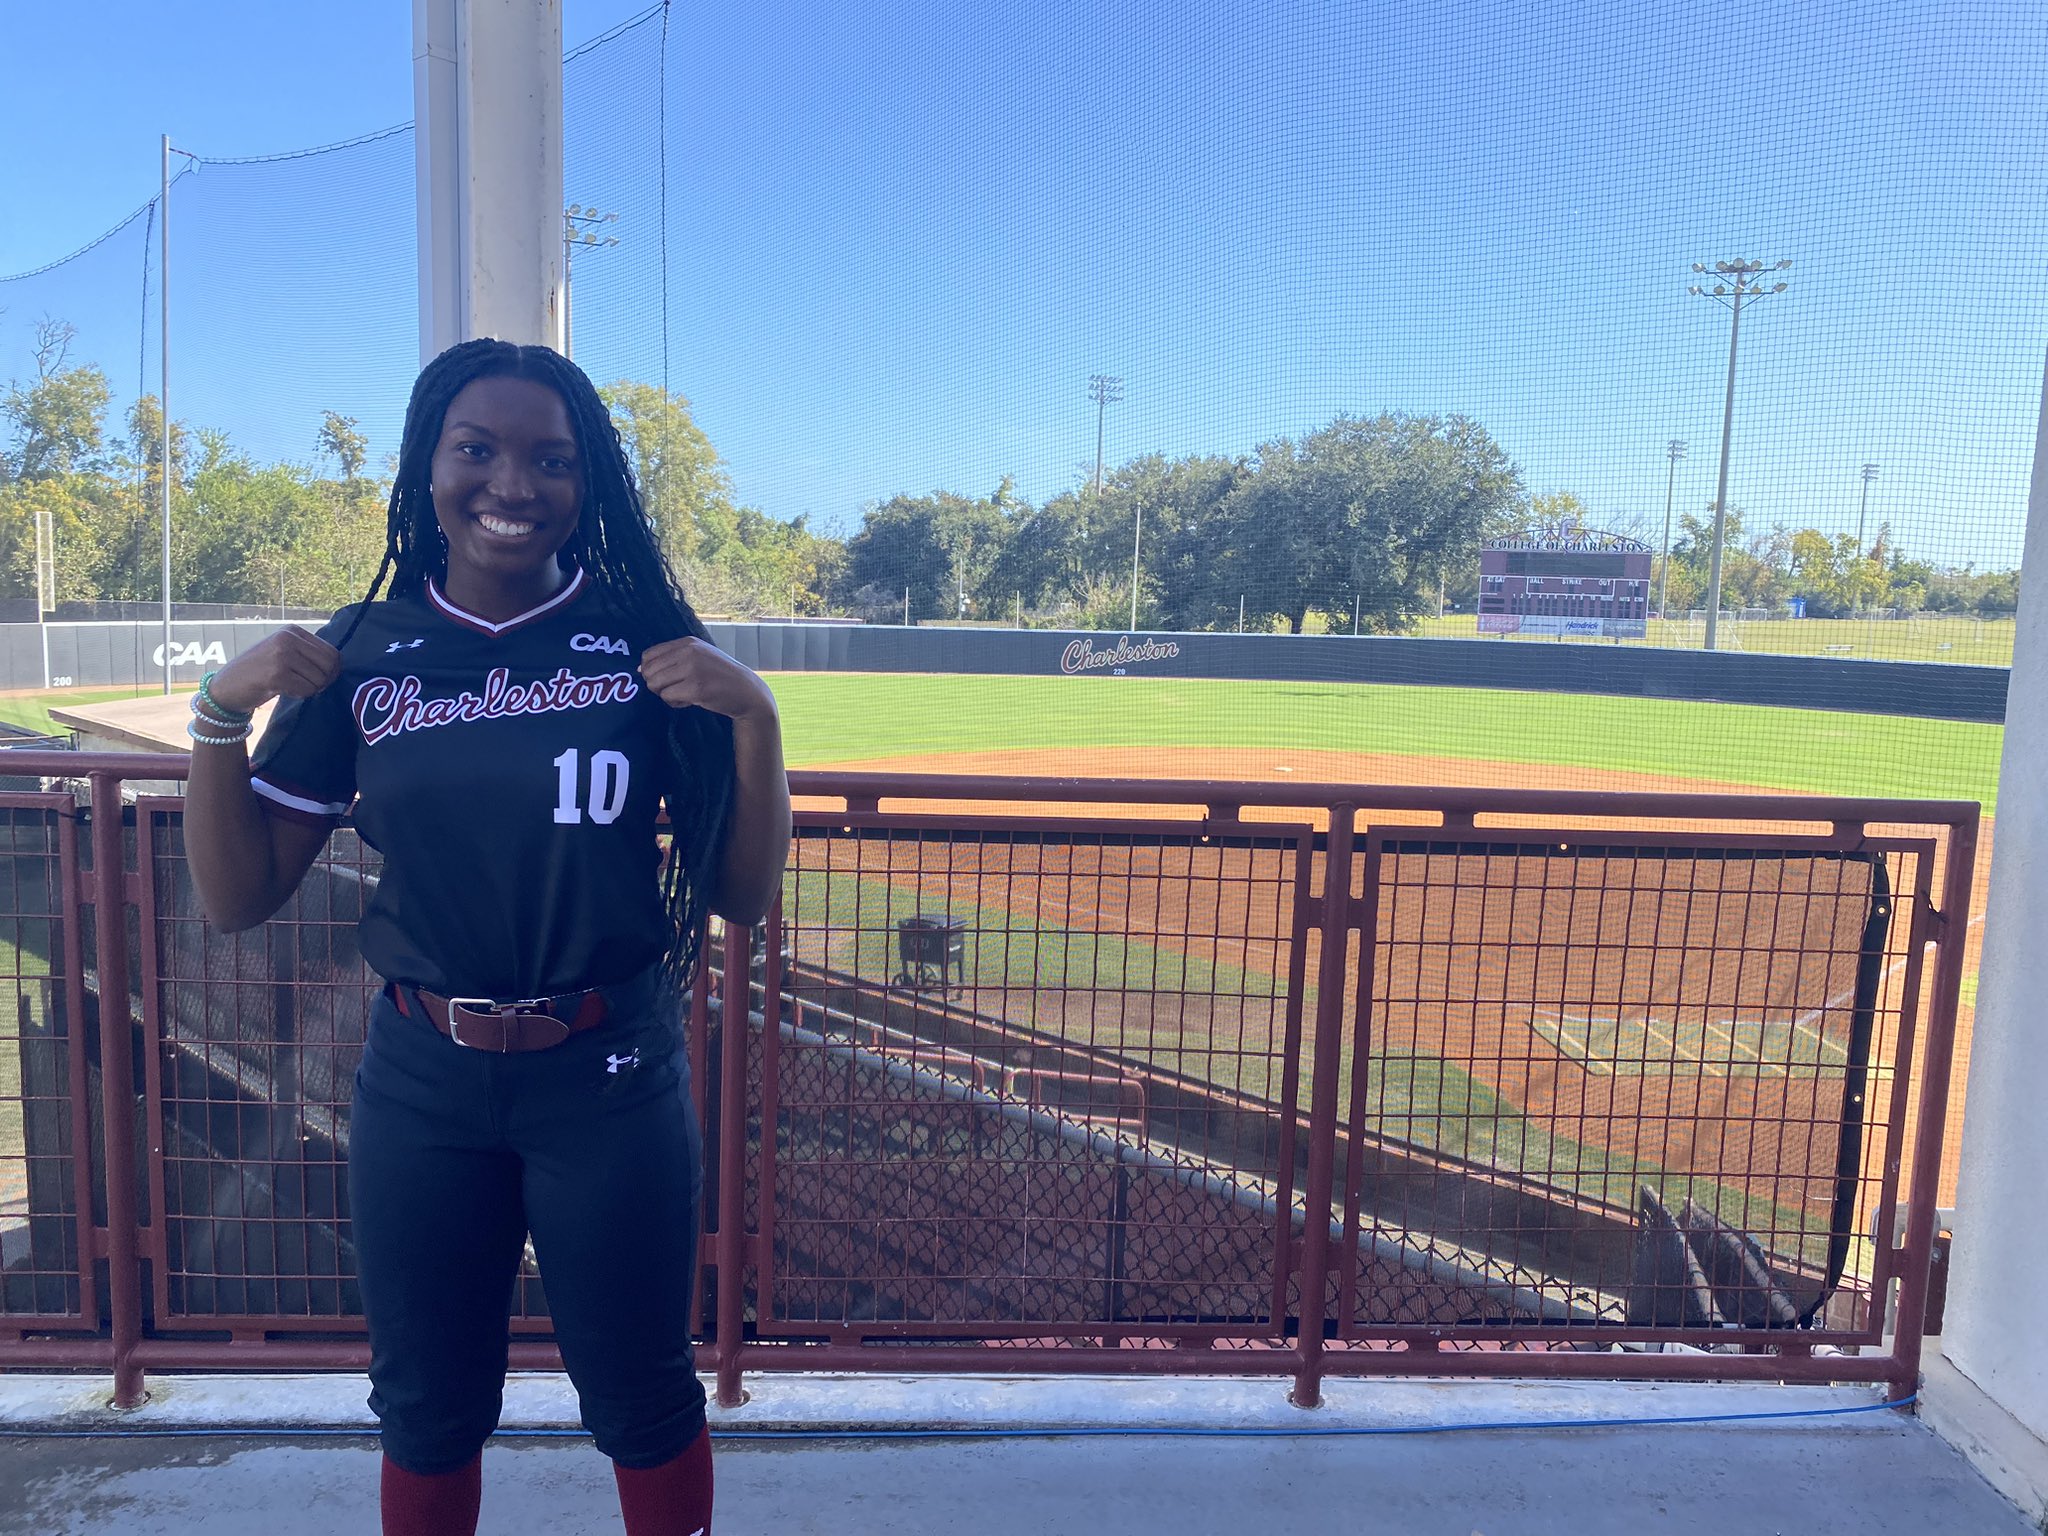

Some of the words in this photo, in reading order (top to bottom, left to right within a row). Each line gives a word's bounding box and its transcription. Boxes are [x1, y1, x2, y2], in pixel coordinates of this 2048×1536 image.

[1566, 621, 1599, 630] Hendrick
[153, 641, 227, 667] CAA
[569, 633, 630, 655] CAA
[1061, 635, 1179, 674] Charleston
[53, 676, 72, 687] 200
[352, 668, 638, 746] Charleston
[553, 748, 630, 825] 10
